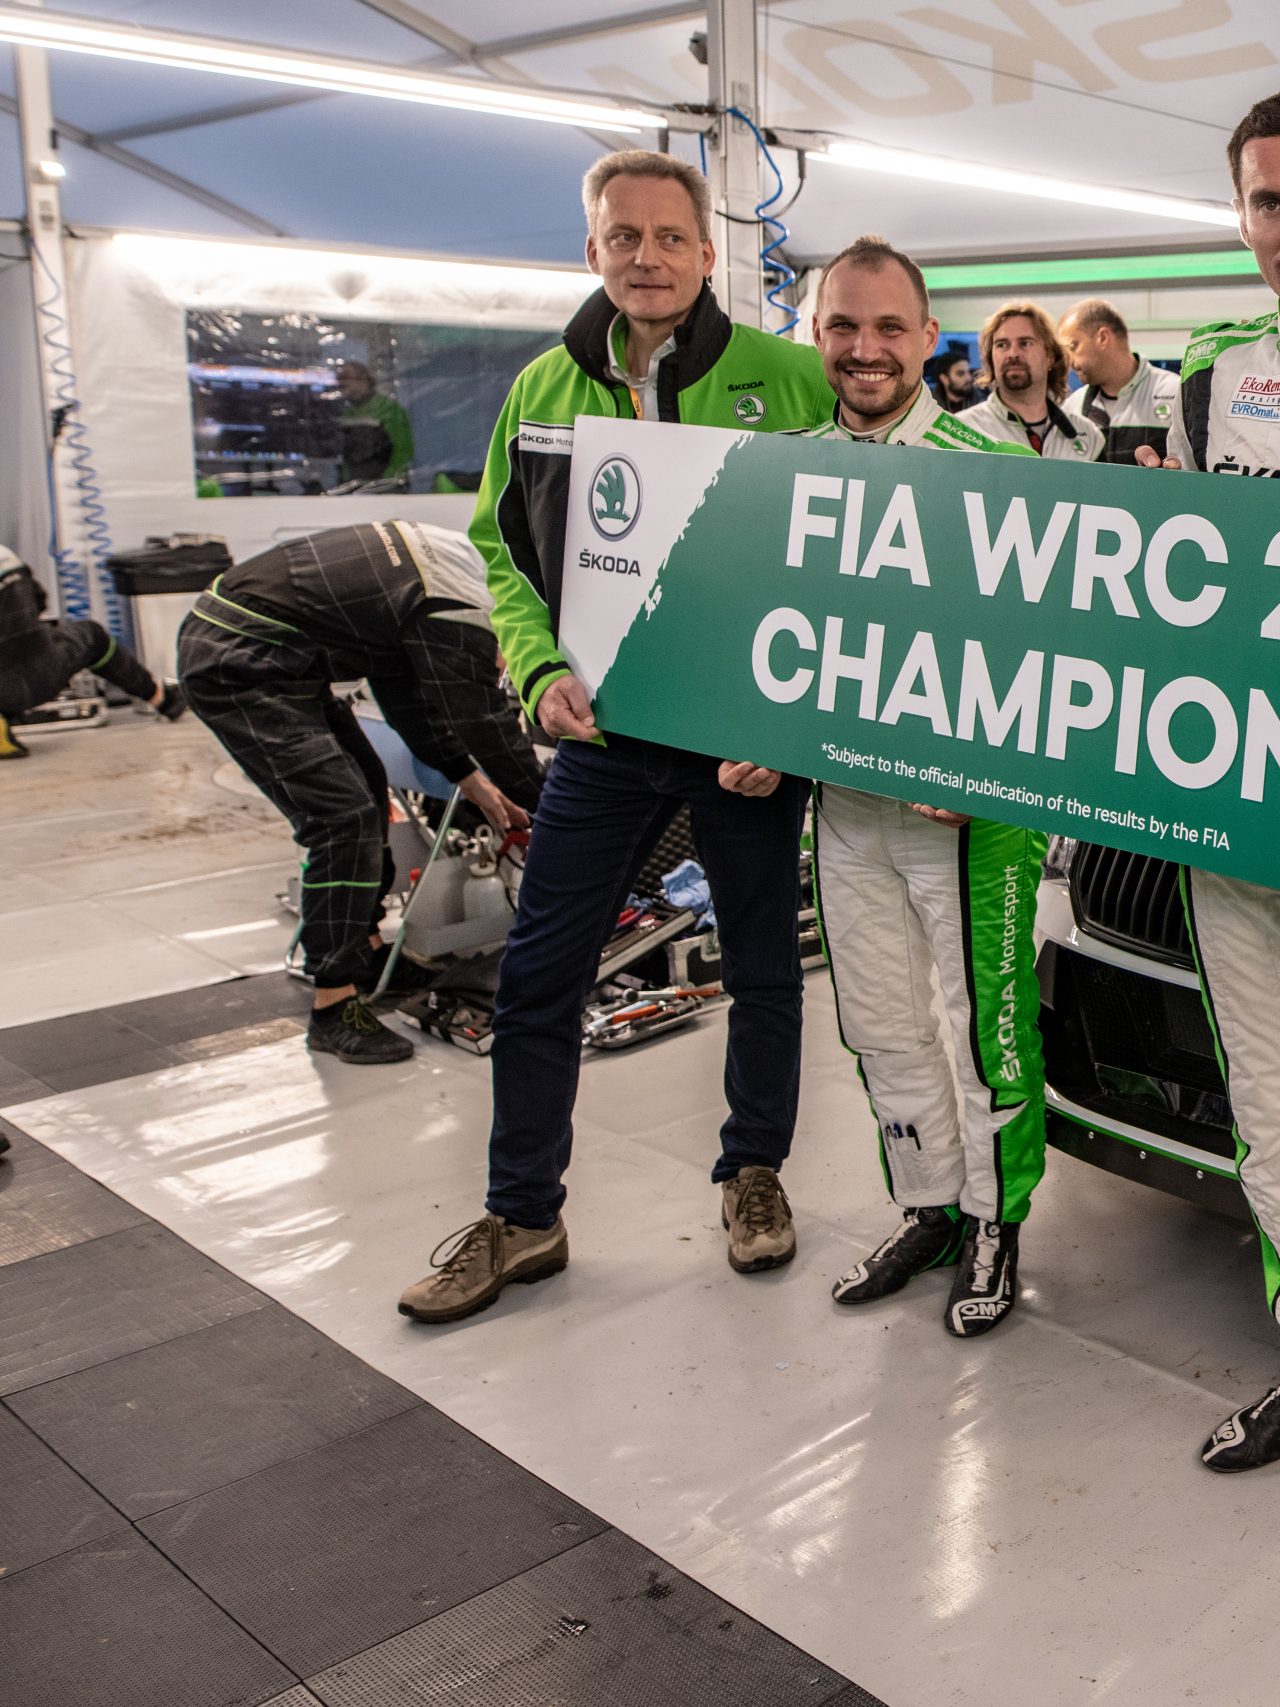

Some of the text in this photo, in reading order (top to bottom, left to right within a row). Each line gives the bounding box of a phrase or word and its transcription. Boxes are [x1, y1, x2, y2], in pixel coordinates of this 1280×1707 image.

[1187, 340, 1217, 361] OMP
[727, 380, 765, 393] ŠKODA
[579, 548, 641, 577] ŠKODA
[786, 473, 930, 586] FIA
[963, 491, 1228, 626] WRC
[877, 757, 892, 773] to
[894, 759, 916, 779] the
[918, 767, 963, 789] official
[966, 779, 1043, 808] publication
[1046, 795, 1063, 811] of
[1066, 798, 1091, 818] the
[1094, 807, 1145, 831] results
[1149, 816, 1169, 839] by
[1172, 822, 1198, 843] the
[1202, 828, 1229, 851] FIA
[998, 864, 1022, 1083] ŠKODA Motorsport
